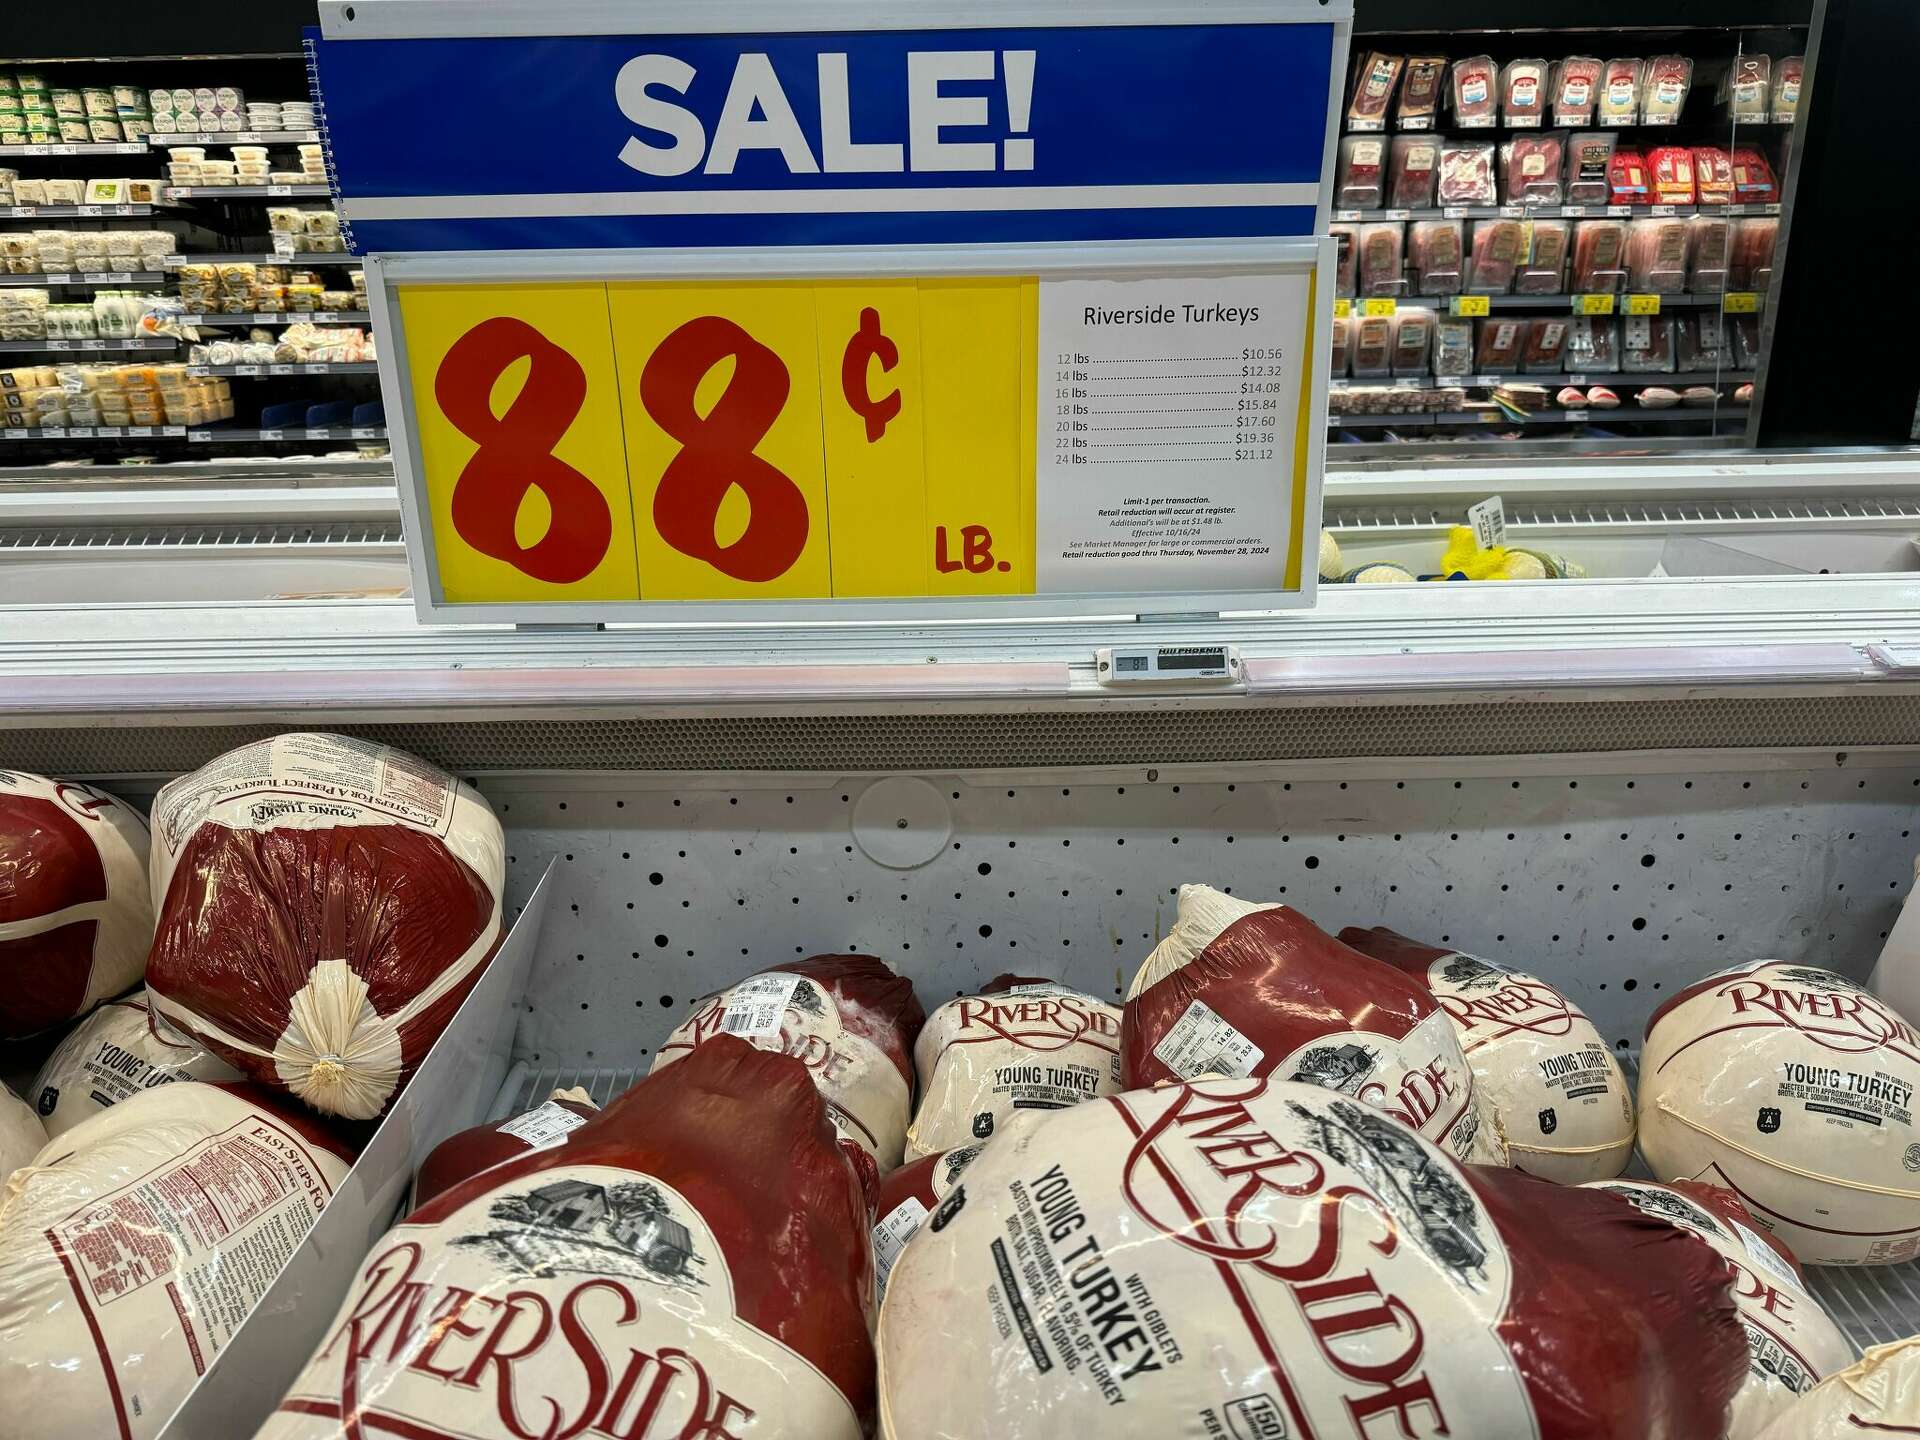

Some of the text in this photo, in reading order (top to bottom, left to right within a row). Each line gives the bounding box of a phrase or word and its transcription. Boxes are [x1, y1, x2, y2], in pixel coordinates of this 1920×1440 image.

[614, 50, 1037, 177] SALE!
[1084, 303, 1259, 325] Riverside Turkeys
[1057, 348, 1282, 364] 12 lbs $10.56
[1056, 365, 1281, 381] 14 lbs $12.32
[1055, 382, 1280, 399] 16 lbs $14.08
[1057, 399, 1277, 415] 18 lbs $15.84
[1056, 416, 1275, 432] 20 lbs $17.60
[1056, 432, 1274, 448] 22 lbs $19.36
[1056, 449, 1273, 465] 24 lbs $21.12
[1098, 509, 1120, 517] Retail
[1121, 508, 1157, 516] reduction
[1158, 507, 1172, 515] will
[1205, 506, 1236, 515] register.
[1151, 498, 1164, 506] per
[1165, 496, 1210, 504] transaction.
[1109, 519, 1154, 527] Additional's
[1155, 518, 1169, 526] will
[1191, 517, 1212, 525] $1.48
[1213, 517, 1223, 525] lb.
[1131, 528, 1201, 537] Effective 10/16/24
[935, 525, 1012, 575] LB.
[1062, 551, 1084, 559] Retail
[1085, 550, 1120, 558] reduction
[1121, 550, 1141, 558] good
[1141, 549, 1157, 557] thru
[1160, 549, 1194, 557] Thursday,
[1196, 548, 1236, 556] November
[1236, 547, 1248, 555] 28,
[1113, 540, 1147, 548] Manager
[1148, 540, 1159, 548] for
[1161, 539, 1180, 547] large
[284, 778, 335, 796] PERFECT
[335, 788, 346, 799] A
[350, 790, 380, 806] FOR
[379, 798, 411, 816] STEPS
[306, 803, 358, 820] YOUNG
[1215, 1026, 1235, 1047] 14.82
[95, 1041, 145, 1080] YOUNG
[1539, 1054, 1578, 1079] YOUNG
[1578, 1049, 1609, 1071] TURKEY
[995, 1067, 1099, 1093] YOUNG TURKEY
[1784, 1062, 1913, 1108] YOUNG TURKEY
[1874, 1070, 1913, 1091] WITH GIBLETS
[1779, 1082, 1913, 1118] INJECTED WITH APPROXIMATELY 9.5% OF TURKEY
[1829, 1095, 1862, 1110] PHOSPHATE,
[1883, 1109, 1913, 1127] FLAVORING.
[237, 1135, 296, 1189] Nutrition Facts
[250, 1127, 290, 1150] EASY
[284, 1149, 315, 1189] STEPS
[1030, 1164, 1086, 1245] YOUNG
[1062, 1235, 1163, 1381] TURKEY
[1009, 1179, 1126, 1407] BASTED WITH APPROXIMATELY 9.5% OF TURKEY
[1022, 1260, 1047, 1305] SUGAR,
[1039, 1301, 1081, 1376] FLAVORING.
[1125, 1273, 1183, 1365] WITH GIBLETS
[1198, 1408, 1223, 1435] PER
[1250, 1401, 1281, 1436] 150
